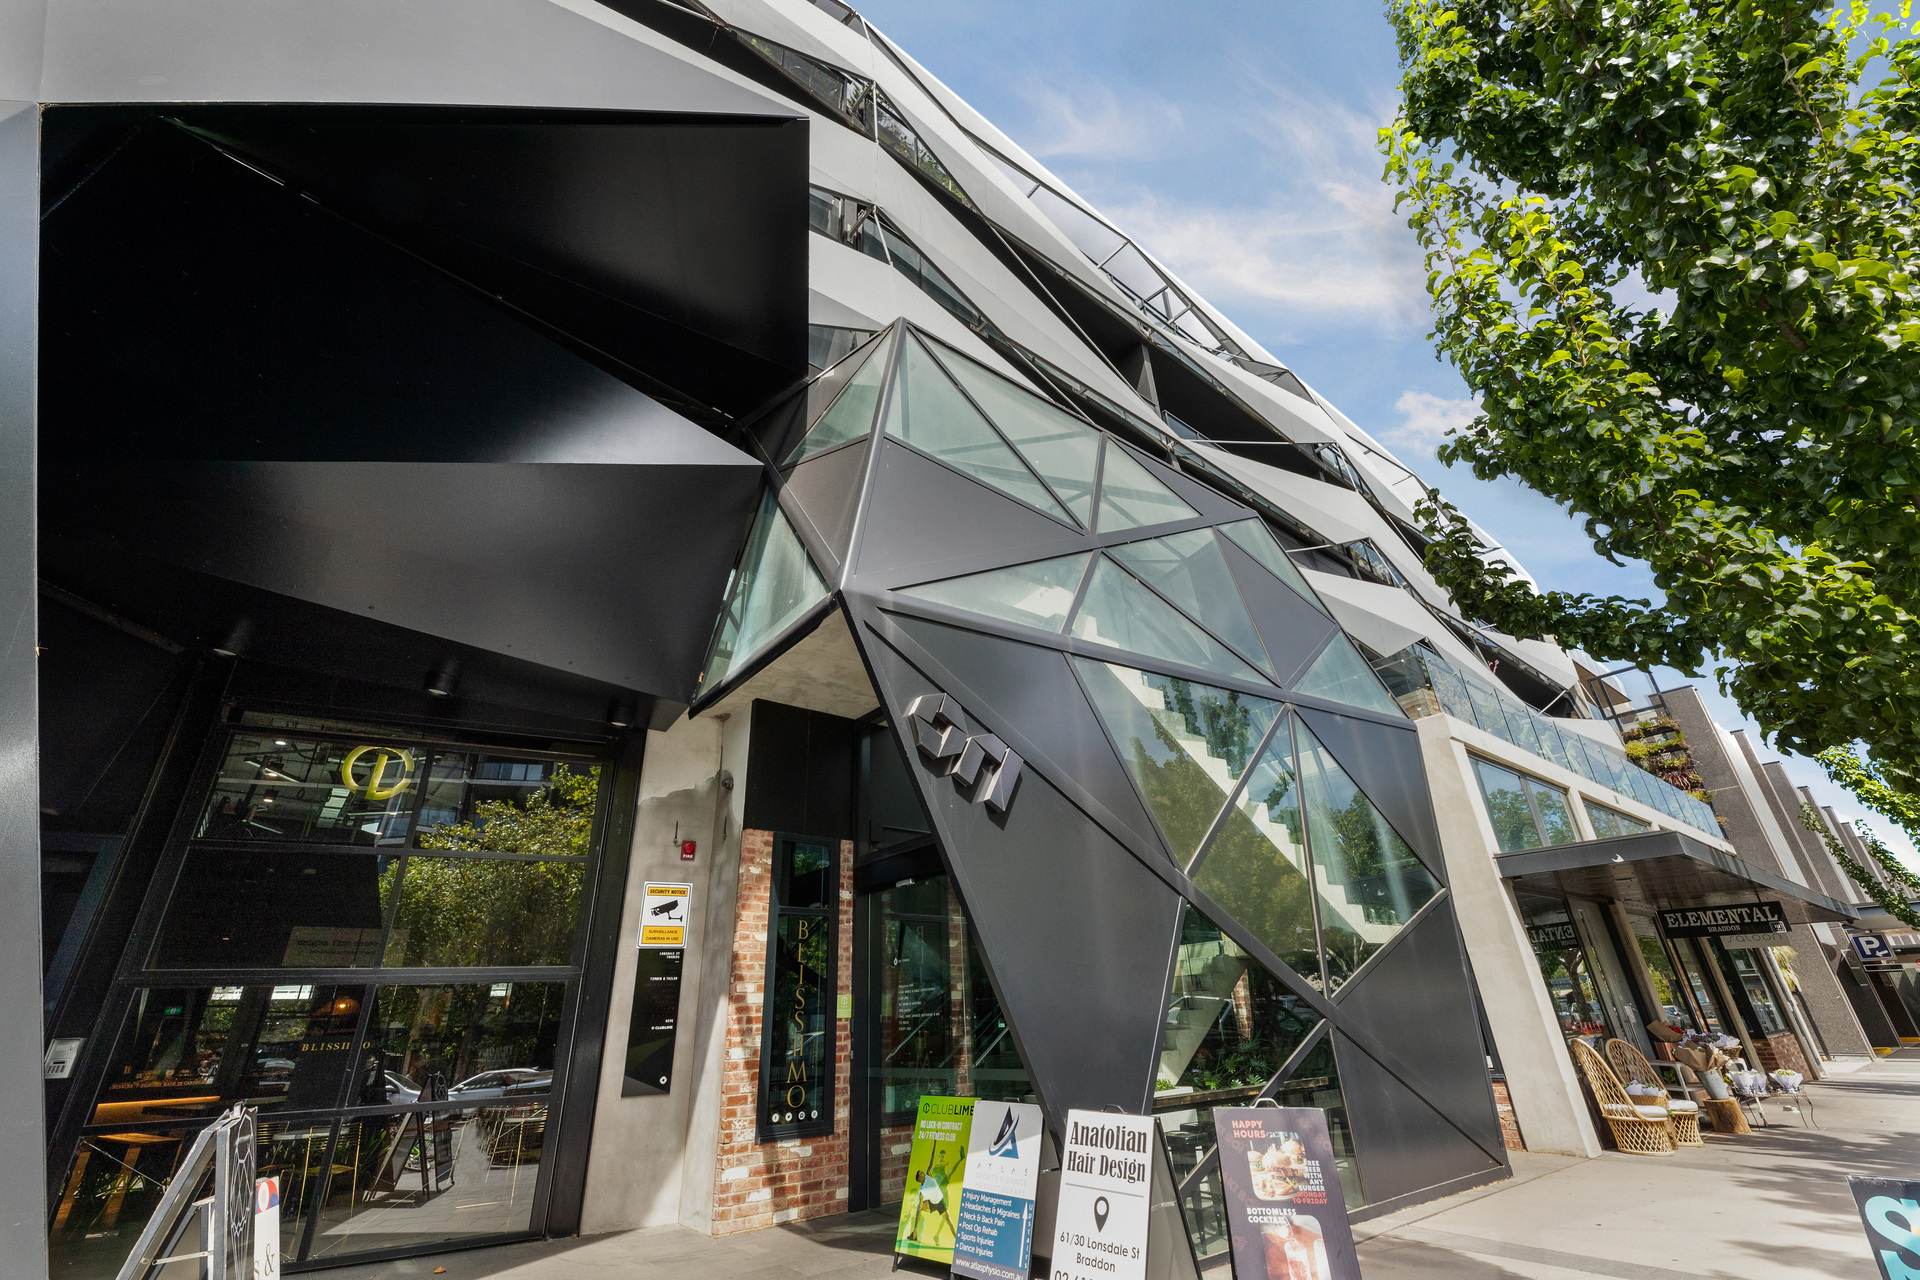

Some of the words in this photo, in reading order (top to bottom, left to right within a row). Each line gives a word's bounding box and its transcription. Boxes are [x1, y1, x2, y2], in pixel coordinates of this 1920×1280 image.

[1664, 906, 1779, 928] ELEMENTAL
[1858, 936, 1880, 955] P
[920, 1120, 926, 1129] NO
[926, 1121, 941, 1130] LOCK-IN
[942, 1122, 963, 1131] CONTRACT
[1231, 1120, 1263, 1129] HAPPY
[918, 1131, 929, 1139] 24/7
[929, 1131, 945, 1141] FITNESS
[945, 1133, 956, 1142] CLUB
[1070, 1121, 1147, 1154] Anatolian
[1233, 1130, 1266, 1139] HOURS
[1066, 1150, 1096, 1175] Hair
[1098, 1154, 1146, 1184] Design
[966, 1191, 980, 1202] Injury
[981, 1194, 1012, 1207] Management
[1302, 1197, 1328, 1205] FRIDAY
[963, 1211, 976, 1221] Neck
[982, 1215, 994, 1225] Back
[994, 1217, 1006, 1227] Pain
[964, 1202, 991, 1214] Headaches
[997, 1208, 1021, 1220] Migraines
[1246, 1207, 1297, 1216] BOTTOMLESS
[961, 1221, 973, 1231] Post
[973, 1224, 982, 1234] Op
[982, 1226, 998, 1237] Rehab
[960, 1231, 977, 1242] Sports
[977, 1235, 995, 1248] Injuries
[1059, 1231, 1085, 1247] 61/30
[1087, 1237, 1129, 1257] Lonsdale
[1131, 1247, 1140, 1260] St
[959, 1242, 976, 1253] Dance
[976, 1245, 994, 1258] Injuries
[264, 1243, 275, 1276] &
[1076, 1252, 1116, 1273] Braddon
[955, 1258, 1024, 1280] www.atlasphysio.com.au
